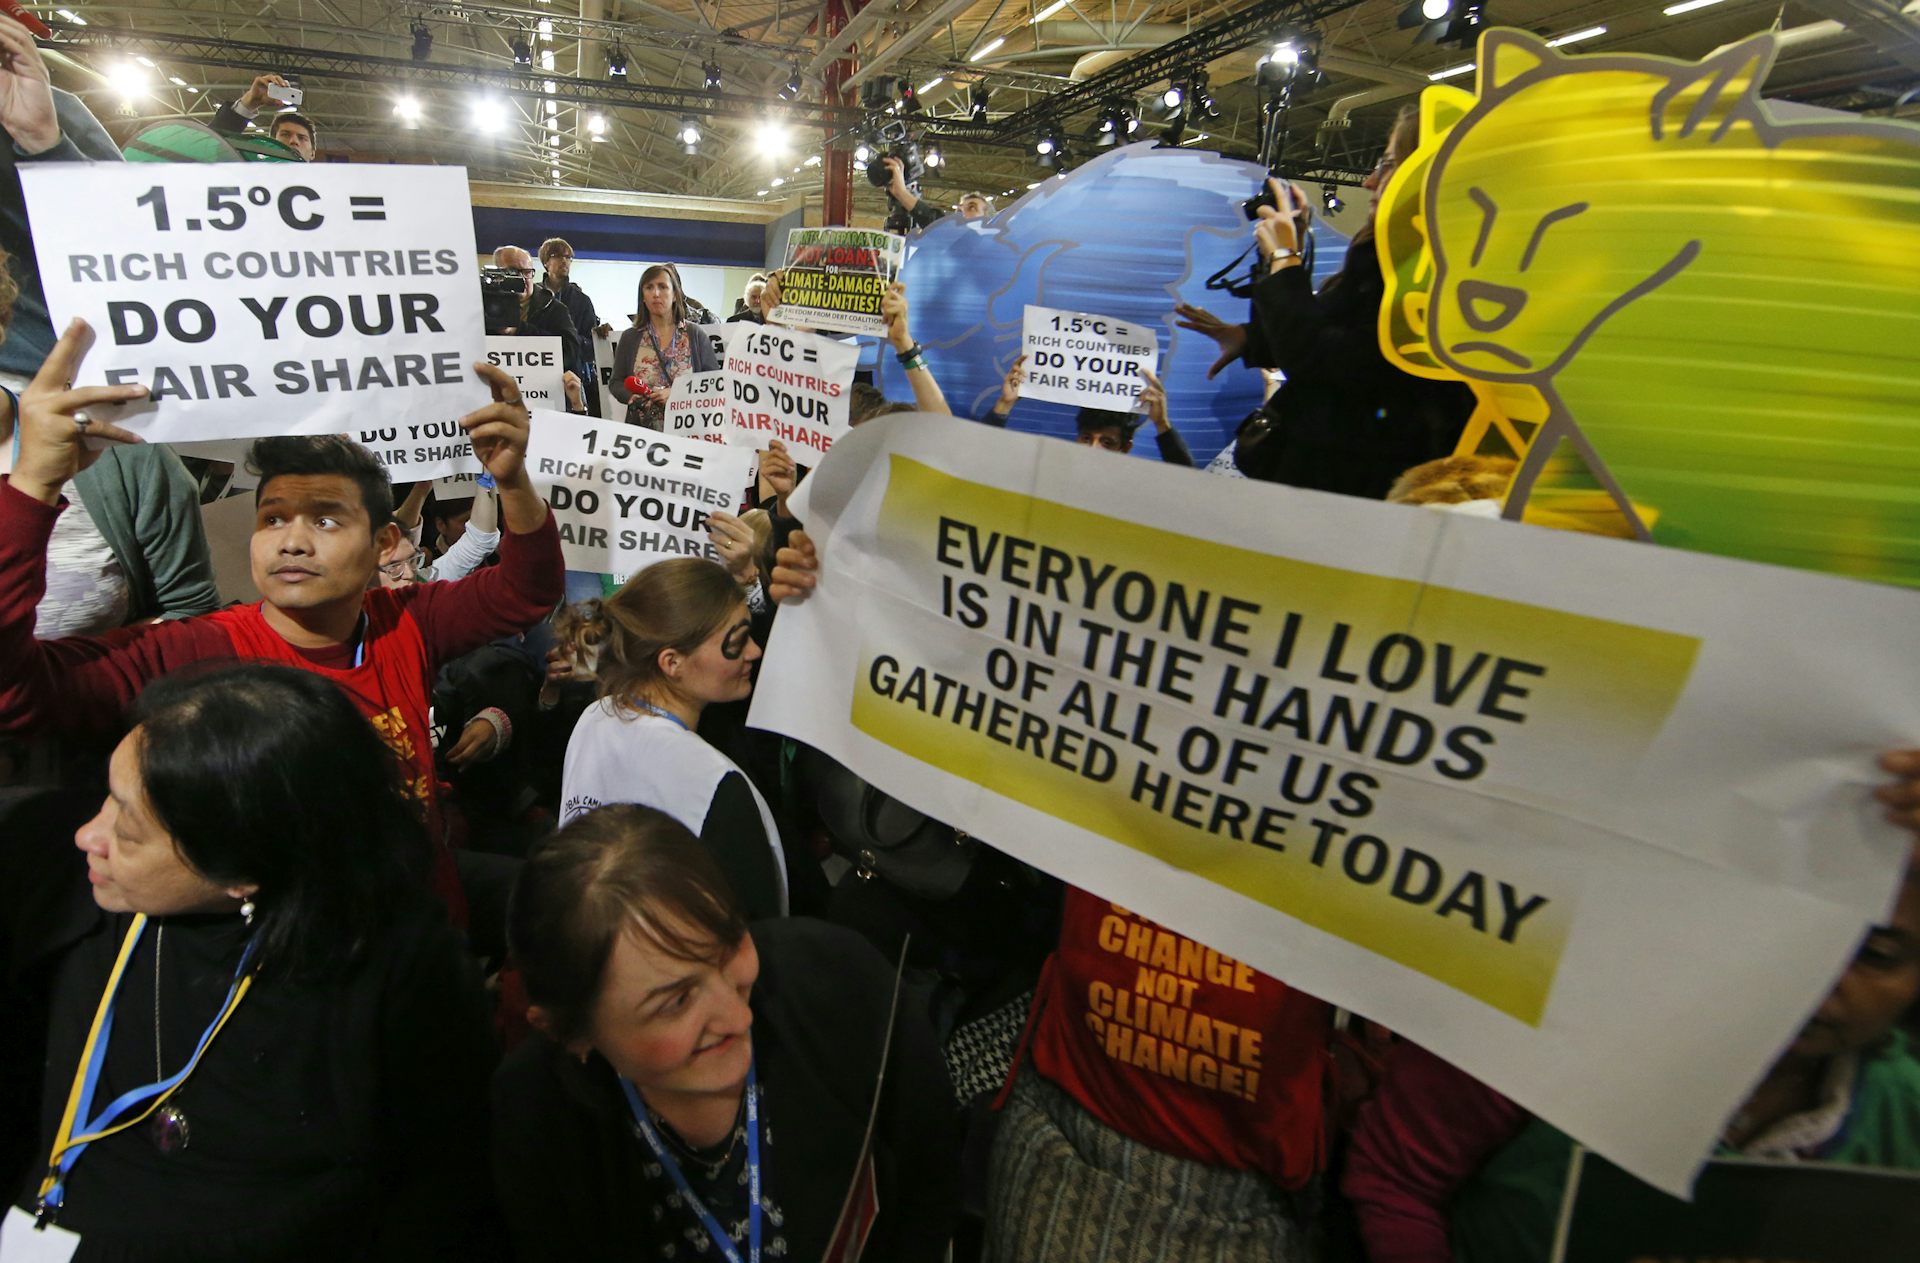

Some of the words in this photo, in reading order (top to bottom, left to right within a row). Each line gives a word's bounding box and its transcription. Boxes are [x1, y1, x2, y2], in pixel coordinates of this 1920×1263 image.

[349, 196, 386, 221] =
[68, 252, 187, 282] RICH
[204, 249, 459, 280] COUNTRIES
[825, 265, 839, 274] FOR
[827, 246, 880, 266] LOANS
[107, 298, 216, 345] DO
[239, 293, 446, 340] YOUR
[782, 289, 879, 313] COMMUNITIES!
[813, 310, 831, 319] FROM
[1028, 335, 1061, 347] RICH
[1066, 338, 1151, 356] COUNTRIES
[105, 363, 257, 406] FAIR
[274, 352, 464, 394] SHARE
[728, 357, 752, 375] RICH
[756, 364, 841, 397] COUNTRIES
[1035, 351, 1064, 368] DO
[1073, 355, 1139, 377] YOUR
[1029, 371, 1069, 389] FAIR
[1075, 378, 1142, 397] SHARE
[670, 400, 692, 411] RICH
[674, 414, 695, 430] DO
[701, 412, 726, 429] YO
[733, 380, 760, 404] DO
[768, 386, 829, 426] YOUR
[361, 428, 396, 443] DO
[731, 408, 772, 430] FAIR
[773, 418, 833, 453] SHARE
[414, 443, 473, 463] SHARE
[683, 454, 704, 470] =
[539, 457, 593, 481] RICH
[600, 467, 731, 508] COUNTRIES
[550, 485, 599, 514] DO
[614, 493, 712, 533] YOUR
[619, 529, 720, 562] SHARE
[937, 516, 1260, 657] EVERYONE
[1273, 612, 1302, 669] I
[1320, 622, 1547, 723] LOVE
[942, 575, 989, 629] IS
[1005, 595, 1062, 657] IN
[1079, 618, 1203, 704] THE
[1213, 664, 1495, 780] HANDS
[986, 648, 1054, 703] OF
[1059, 680, 1159, 755] ALL
[1177, 726, 1268, 785] OF
[1280, 754, 1380, 818] US
[870, 654, 1117, 783] GATHERED
[1130, 761, 1297, 852] HERE
[1310, 818, 1550, 944] TODAY
[1098, 915, 1255, 993] CHANGE
[1135, 966, 1199, 1008] NOT
[1088, 980, 1263, 1069] CLIMATE
[1085, 1011, 1260, 1102] CHANGE!
